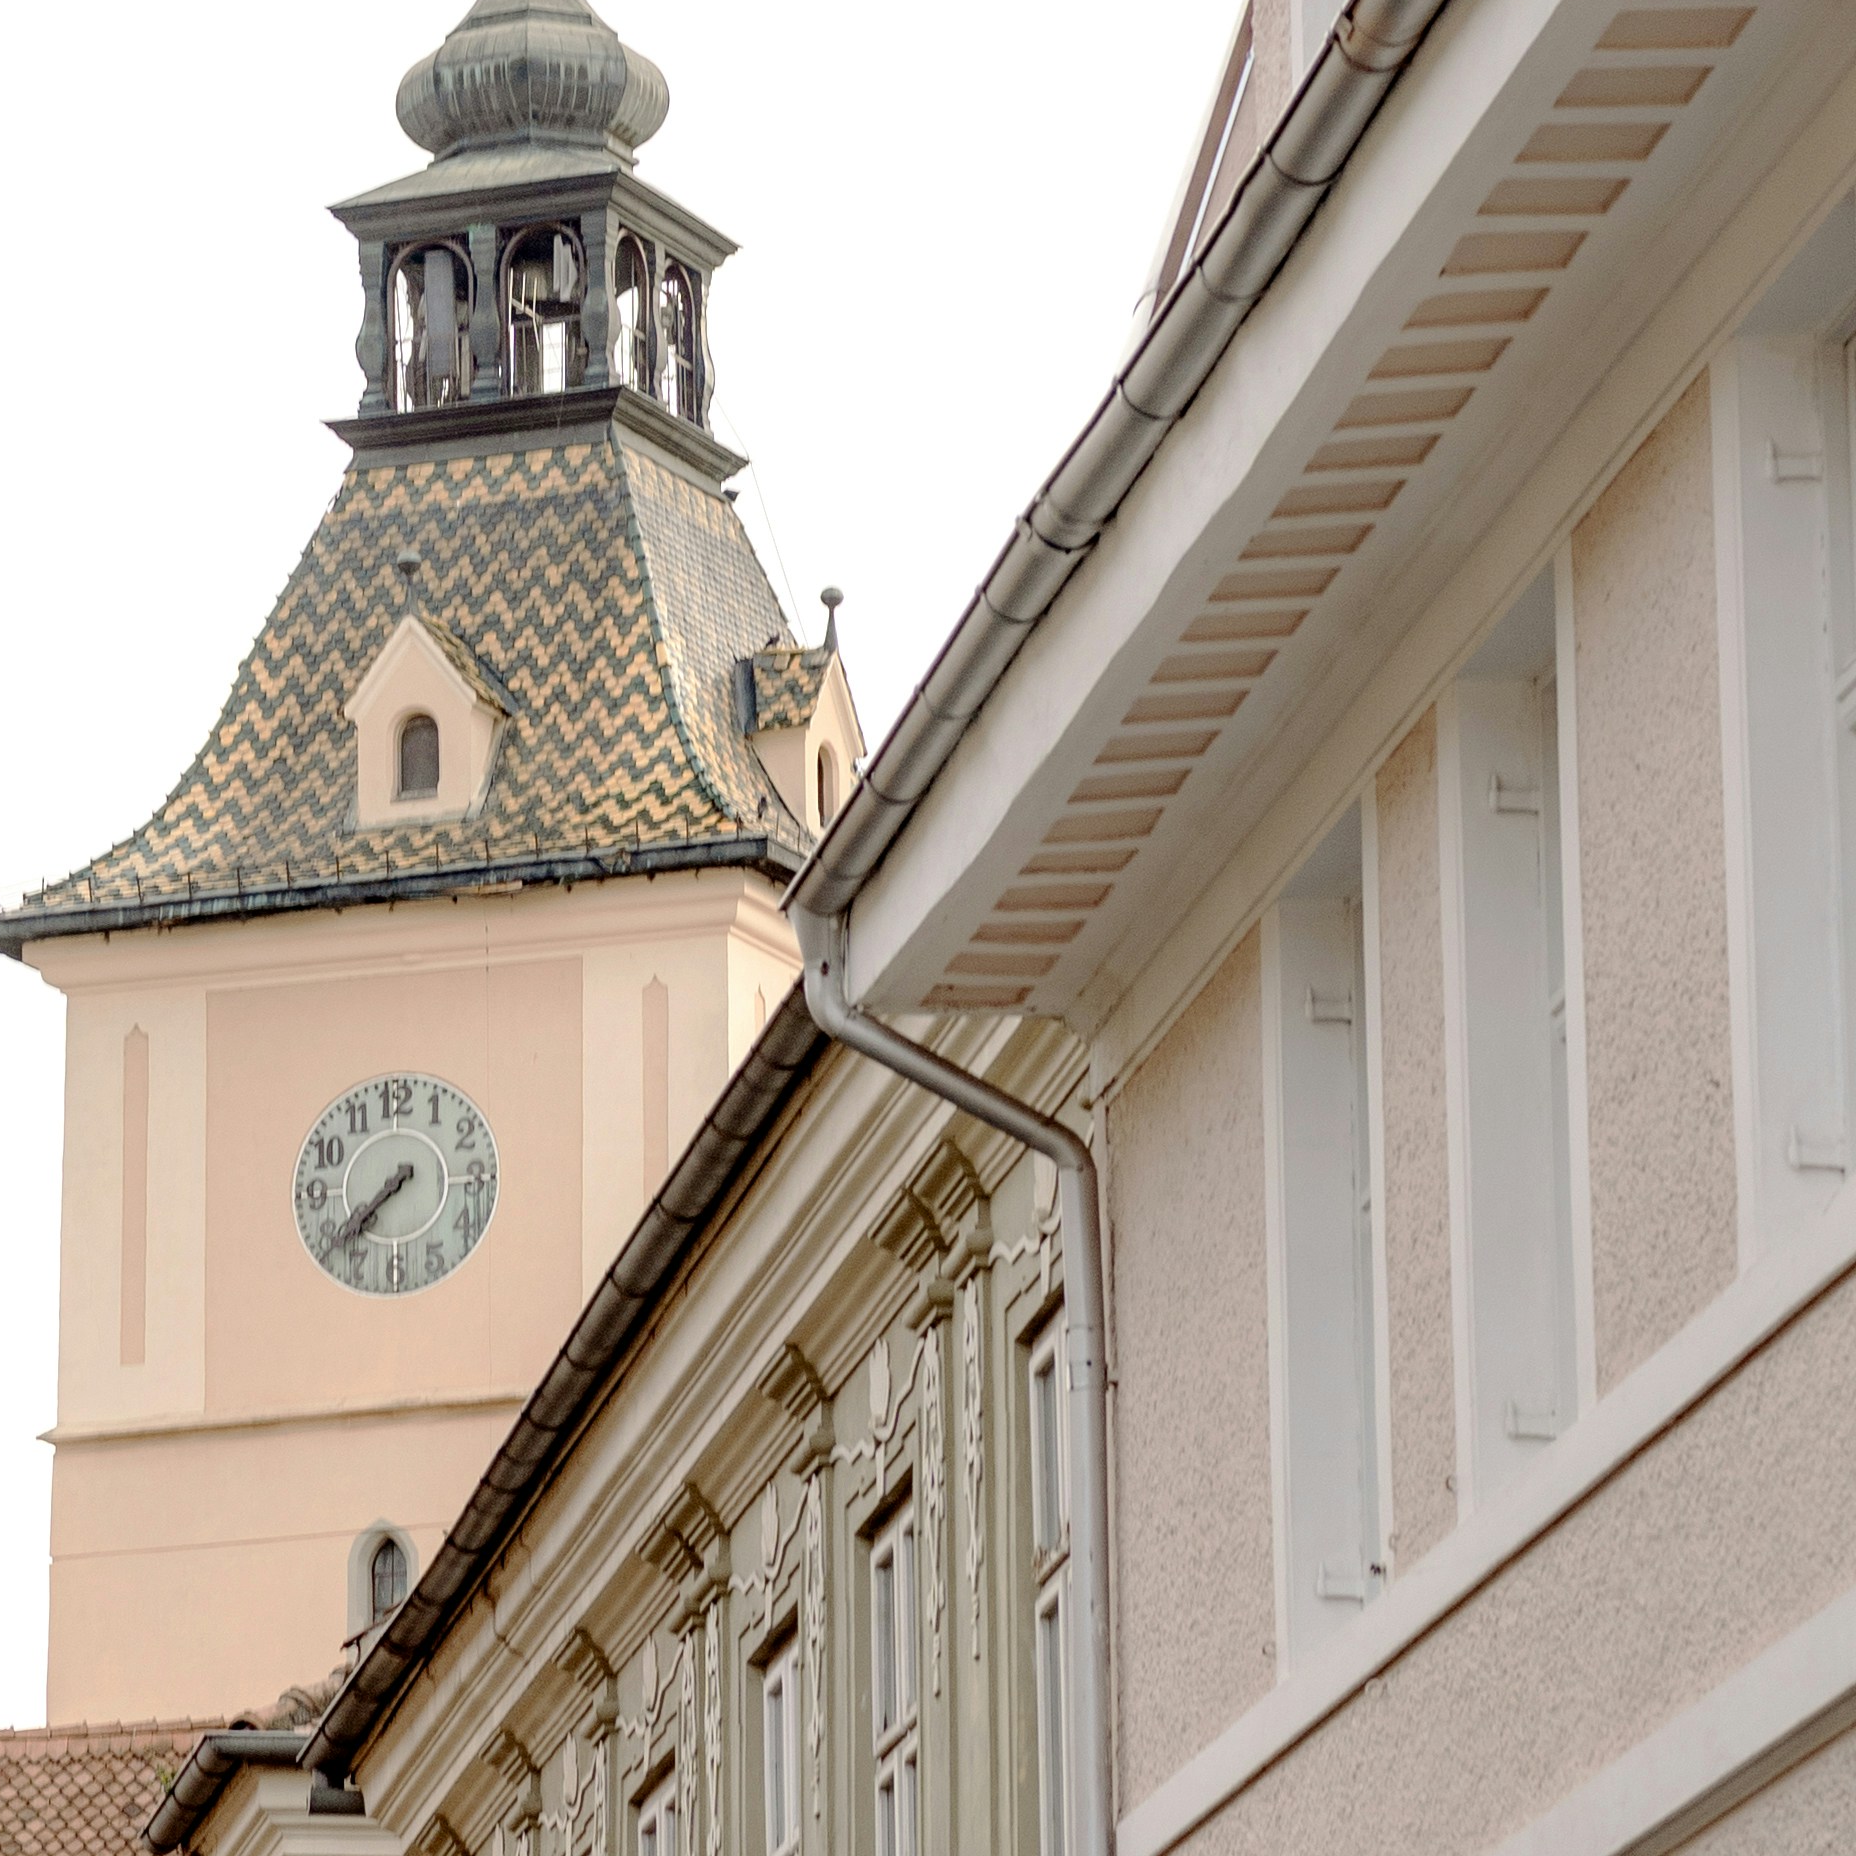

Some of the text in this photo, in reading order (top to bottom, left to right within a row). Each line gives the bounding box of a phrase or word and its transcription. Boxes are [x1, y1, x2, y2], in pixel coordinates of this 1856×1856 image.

[347, 1103, 369, 1134] 11
[379, 1084, 414, 1120] 12
[428, 1092, 442, 1125] 1
[455, 1117, 476, 1150] 2
[314, 1136, 345, 1170] 10
[306, 1179, 327, 1210] 9
[464, 1160, 485, 1195] 3
[453, 1207, 475, 1245] 4
[349, 1246, 368, 1281] 7
[386, 1252, 405, 1286] 6
[424, 1242, 445, 1274] 5
